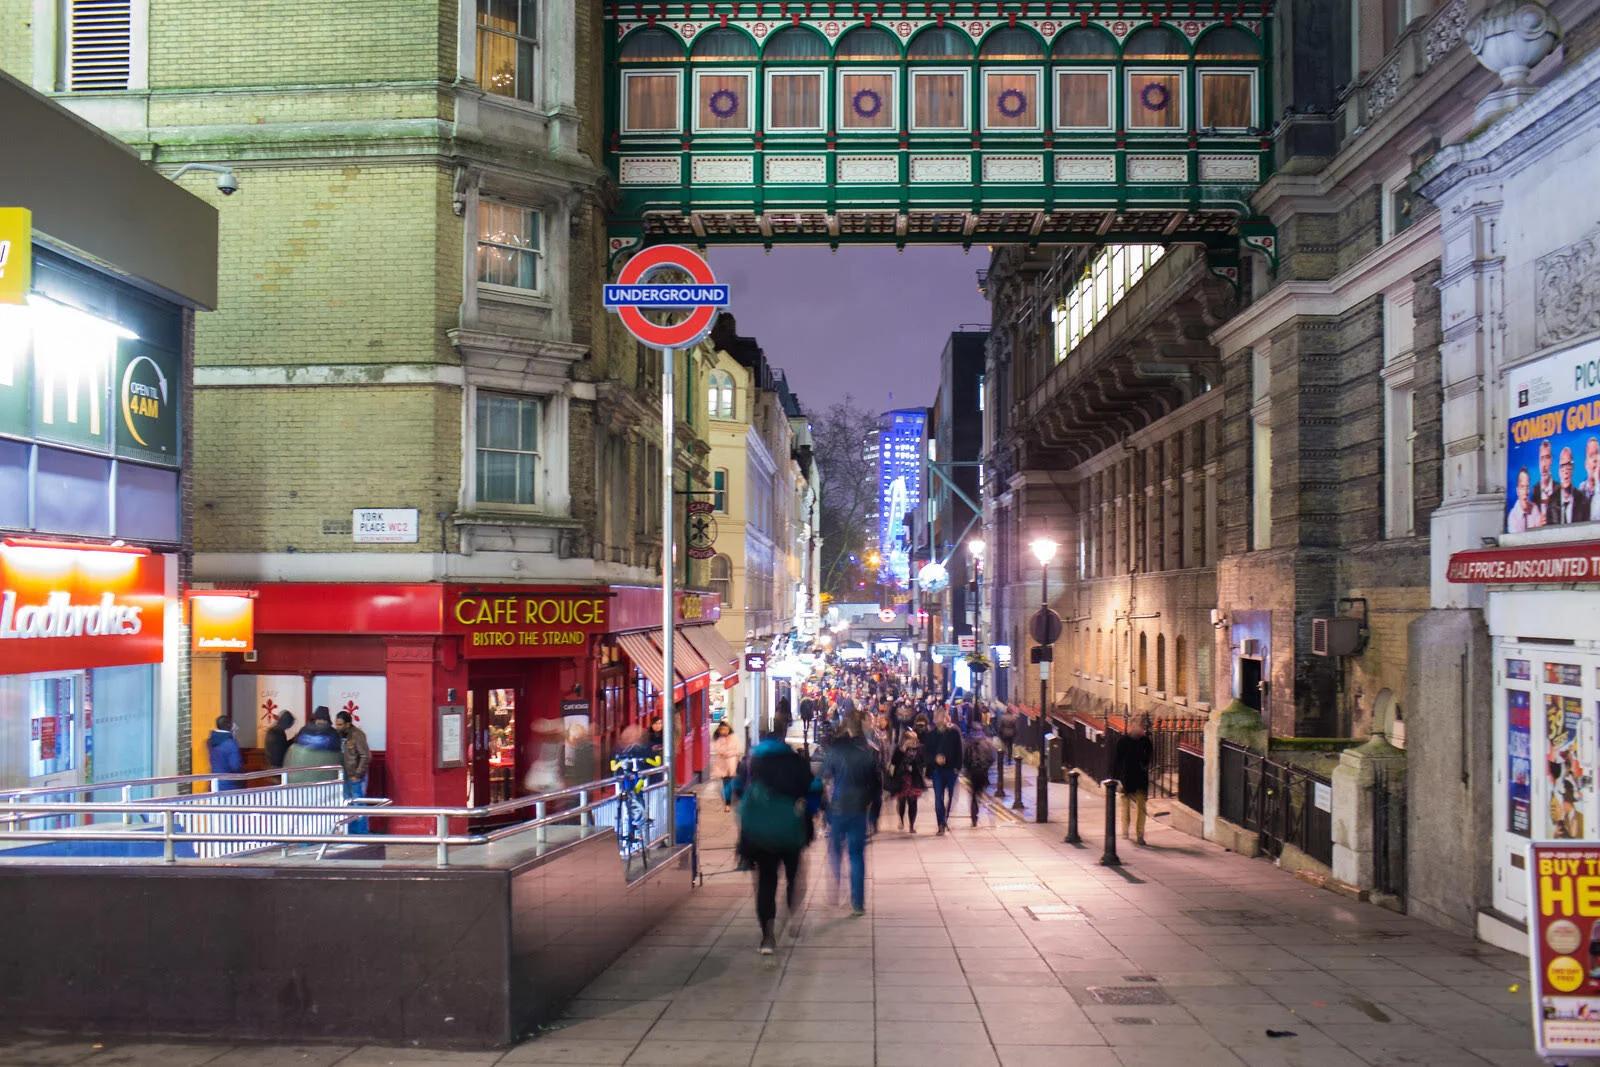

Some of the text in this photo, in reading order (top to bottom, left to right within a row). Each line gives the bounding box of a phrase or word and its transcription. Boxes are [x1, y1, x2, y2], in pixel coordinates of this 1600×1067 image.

[608, 289, 725, 301] UNDERGROUND
[360, 512, 384, 521] YORK
[360, 522, 385, 532] PLACE
[389, 522, 408, 532] WC2
[1512, 558, 1588, 577] DISCOUNTED
[1591, 556, 1600, 575] T
[0, 591, 143, 638] Ladbrokes
[455, 596, 604, 625] CAFÉ ROUGE
[473, 631, 585, 646] BISTRO THE STRAND
[1540, 859, 1580, 876] BUY
